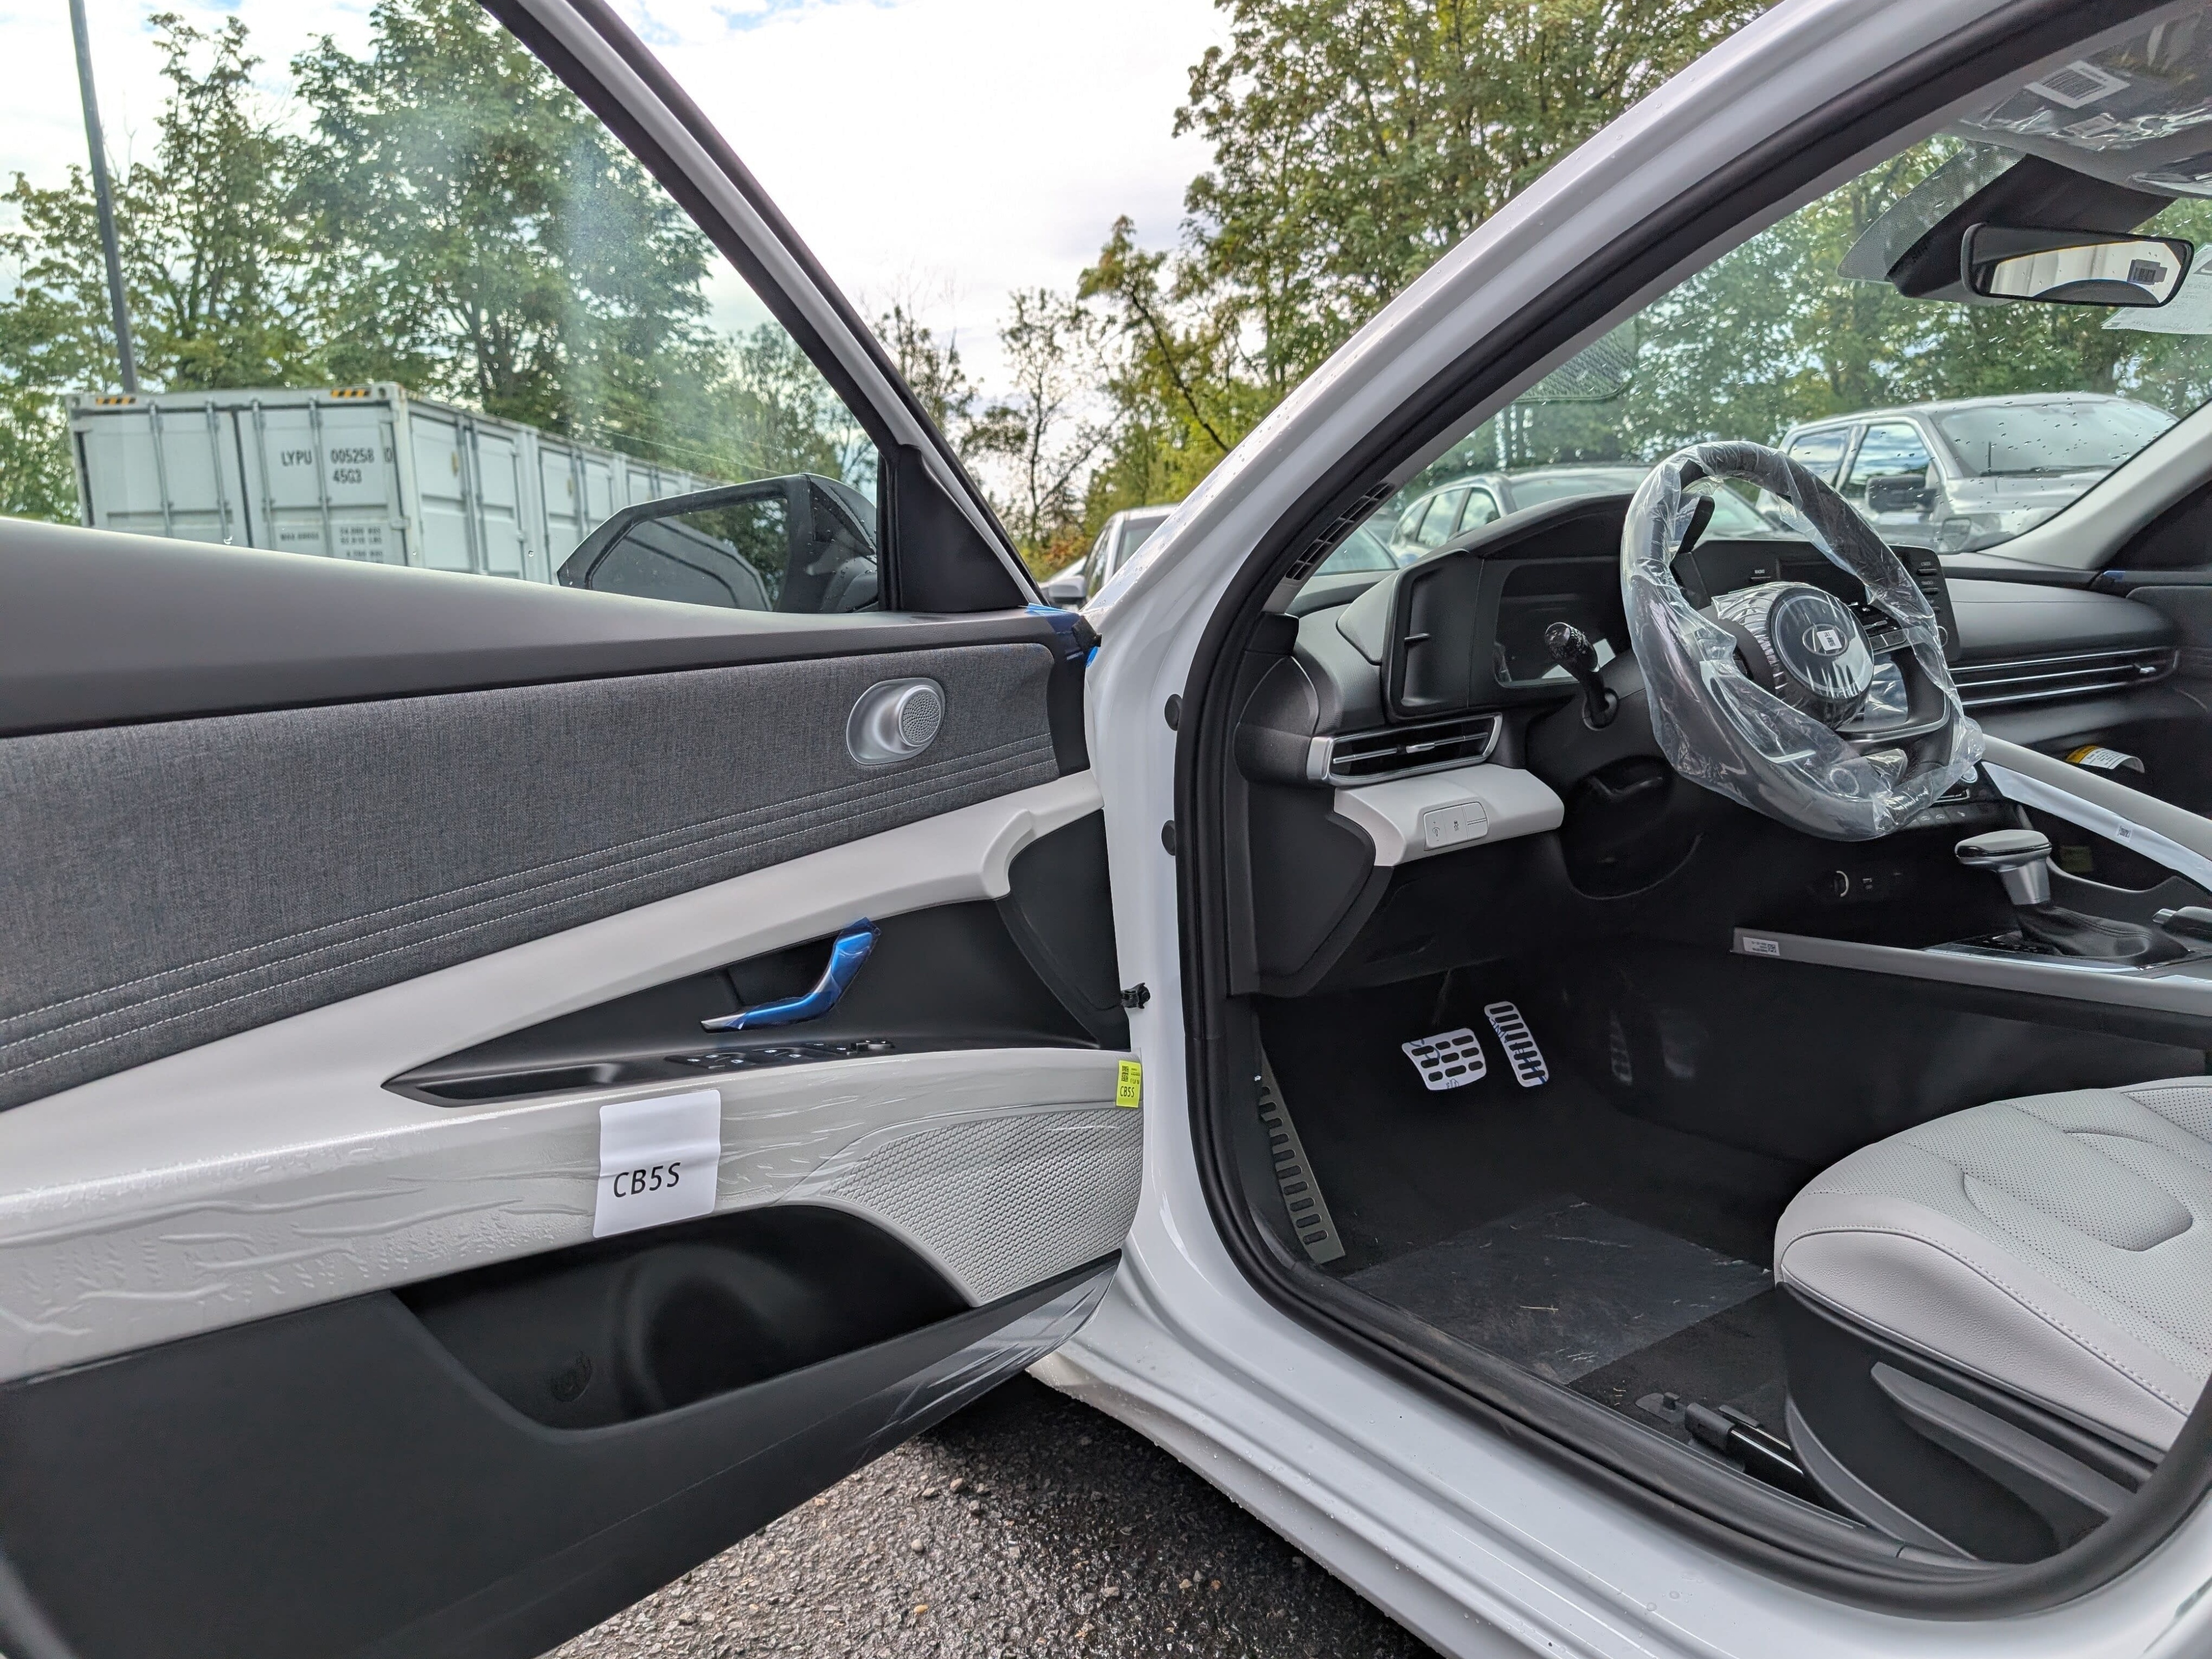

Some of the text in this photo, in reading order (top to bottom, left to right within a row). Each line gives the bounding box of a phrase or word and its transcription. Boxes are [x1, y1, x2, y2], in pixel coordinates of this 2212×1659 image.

[281, 450, 312, 466] LYPU
[330, 447, 375, 464] 005258
[1120, 1086, 1135, 1098] CB5S
[613, 1162, 681, 1198] CB5S
